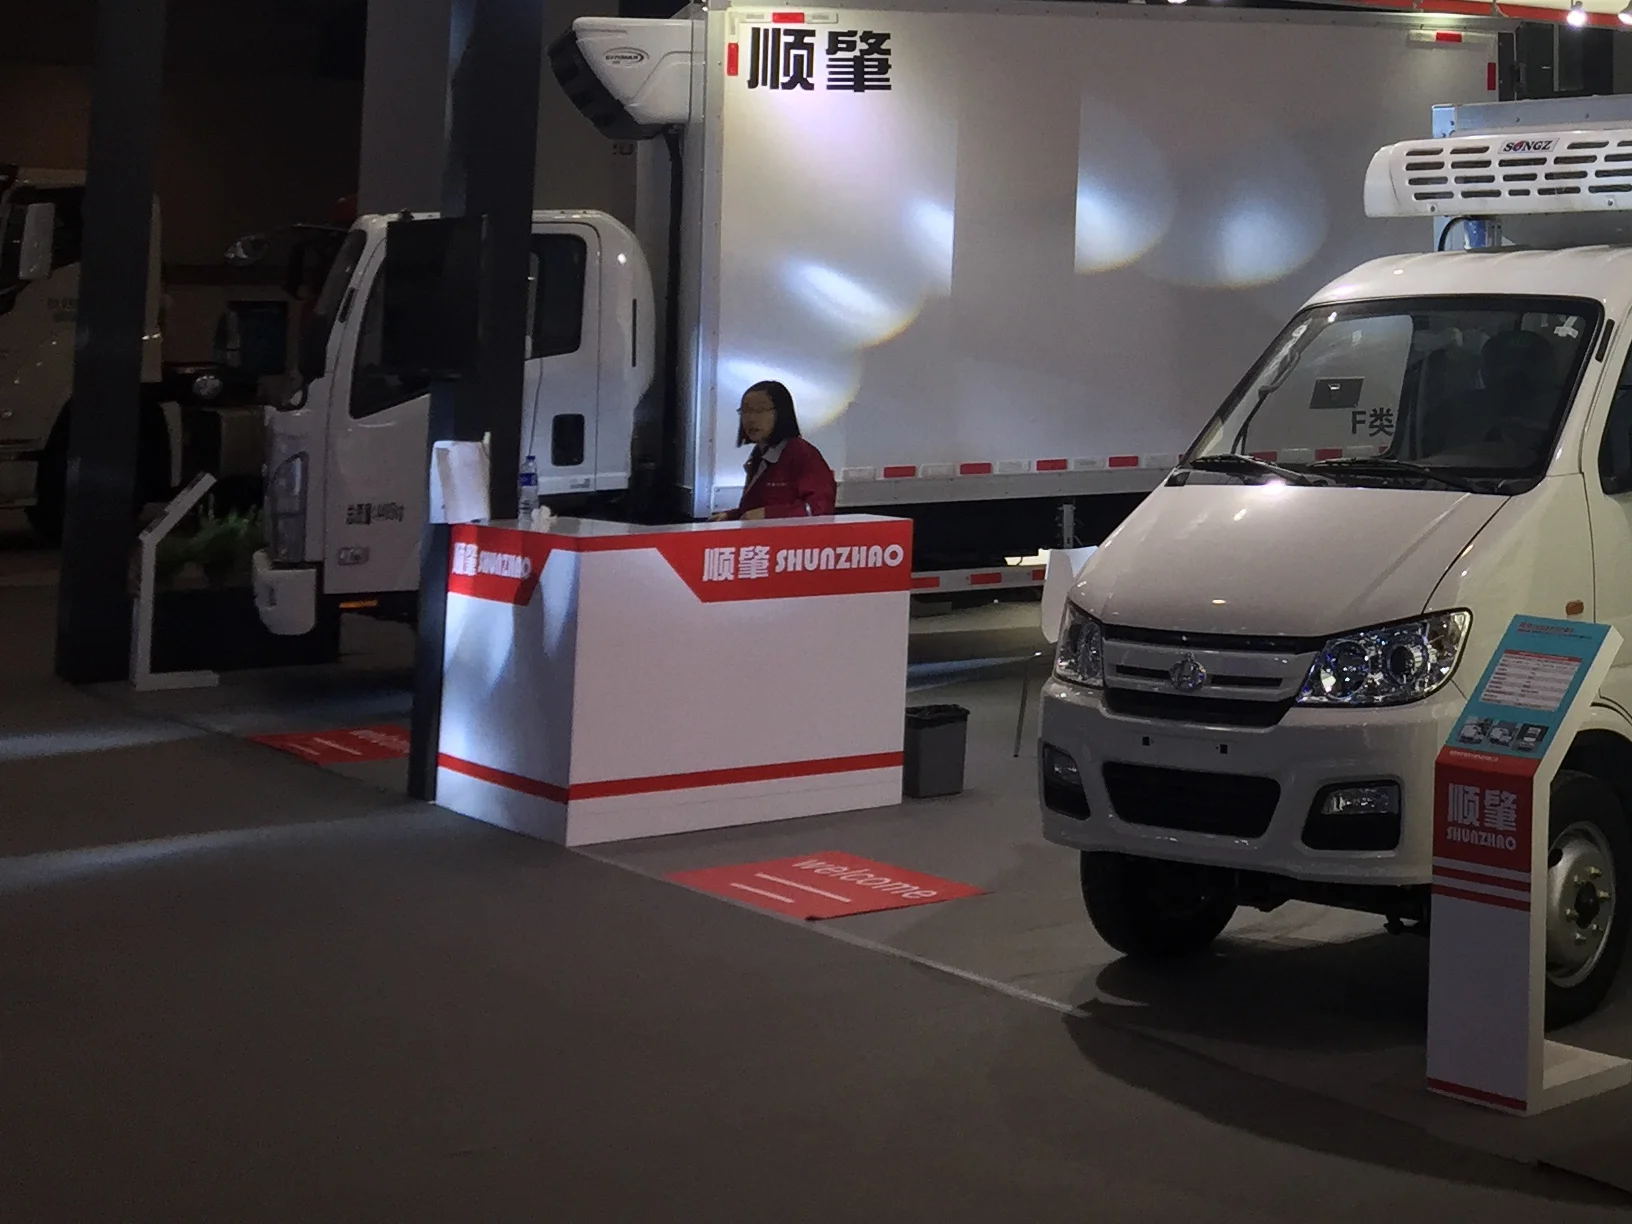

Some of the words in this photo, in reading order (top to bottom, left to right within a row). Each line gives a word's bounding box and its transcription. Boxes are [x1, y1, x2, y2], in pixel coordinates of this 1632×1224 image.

[748, 27, 892, 92] 顺肇
[1504, 139, 1553, 153] SONGZ
[1351, 407, 1394, 437] F类
[702, 544, 770, 582] 顺肇
[776, 543, 904, 575] SHUNZHAO
[1447, 783, 1518, 832] 顺肇
[1446, 827, 1517, 851] SHUNZHAO
[792, 856, 939, 903] welcome
